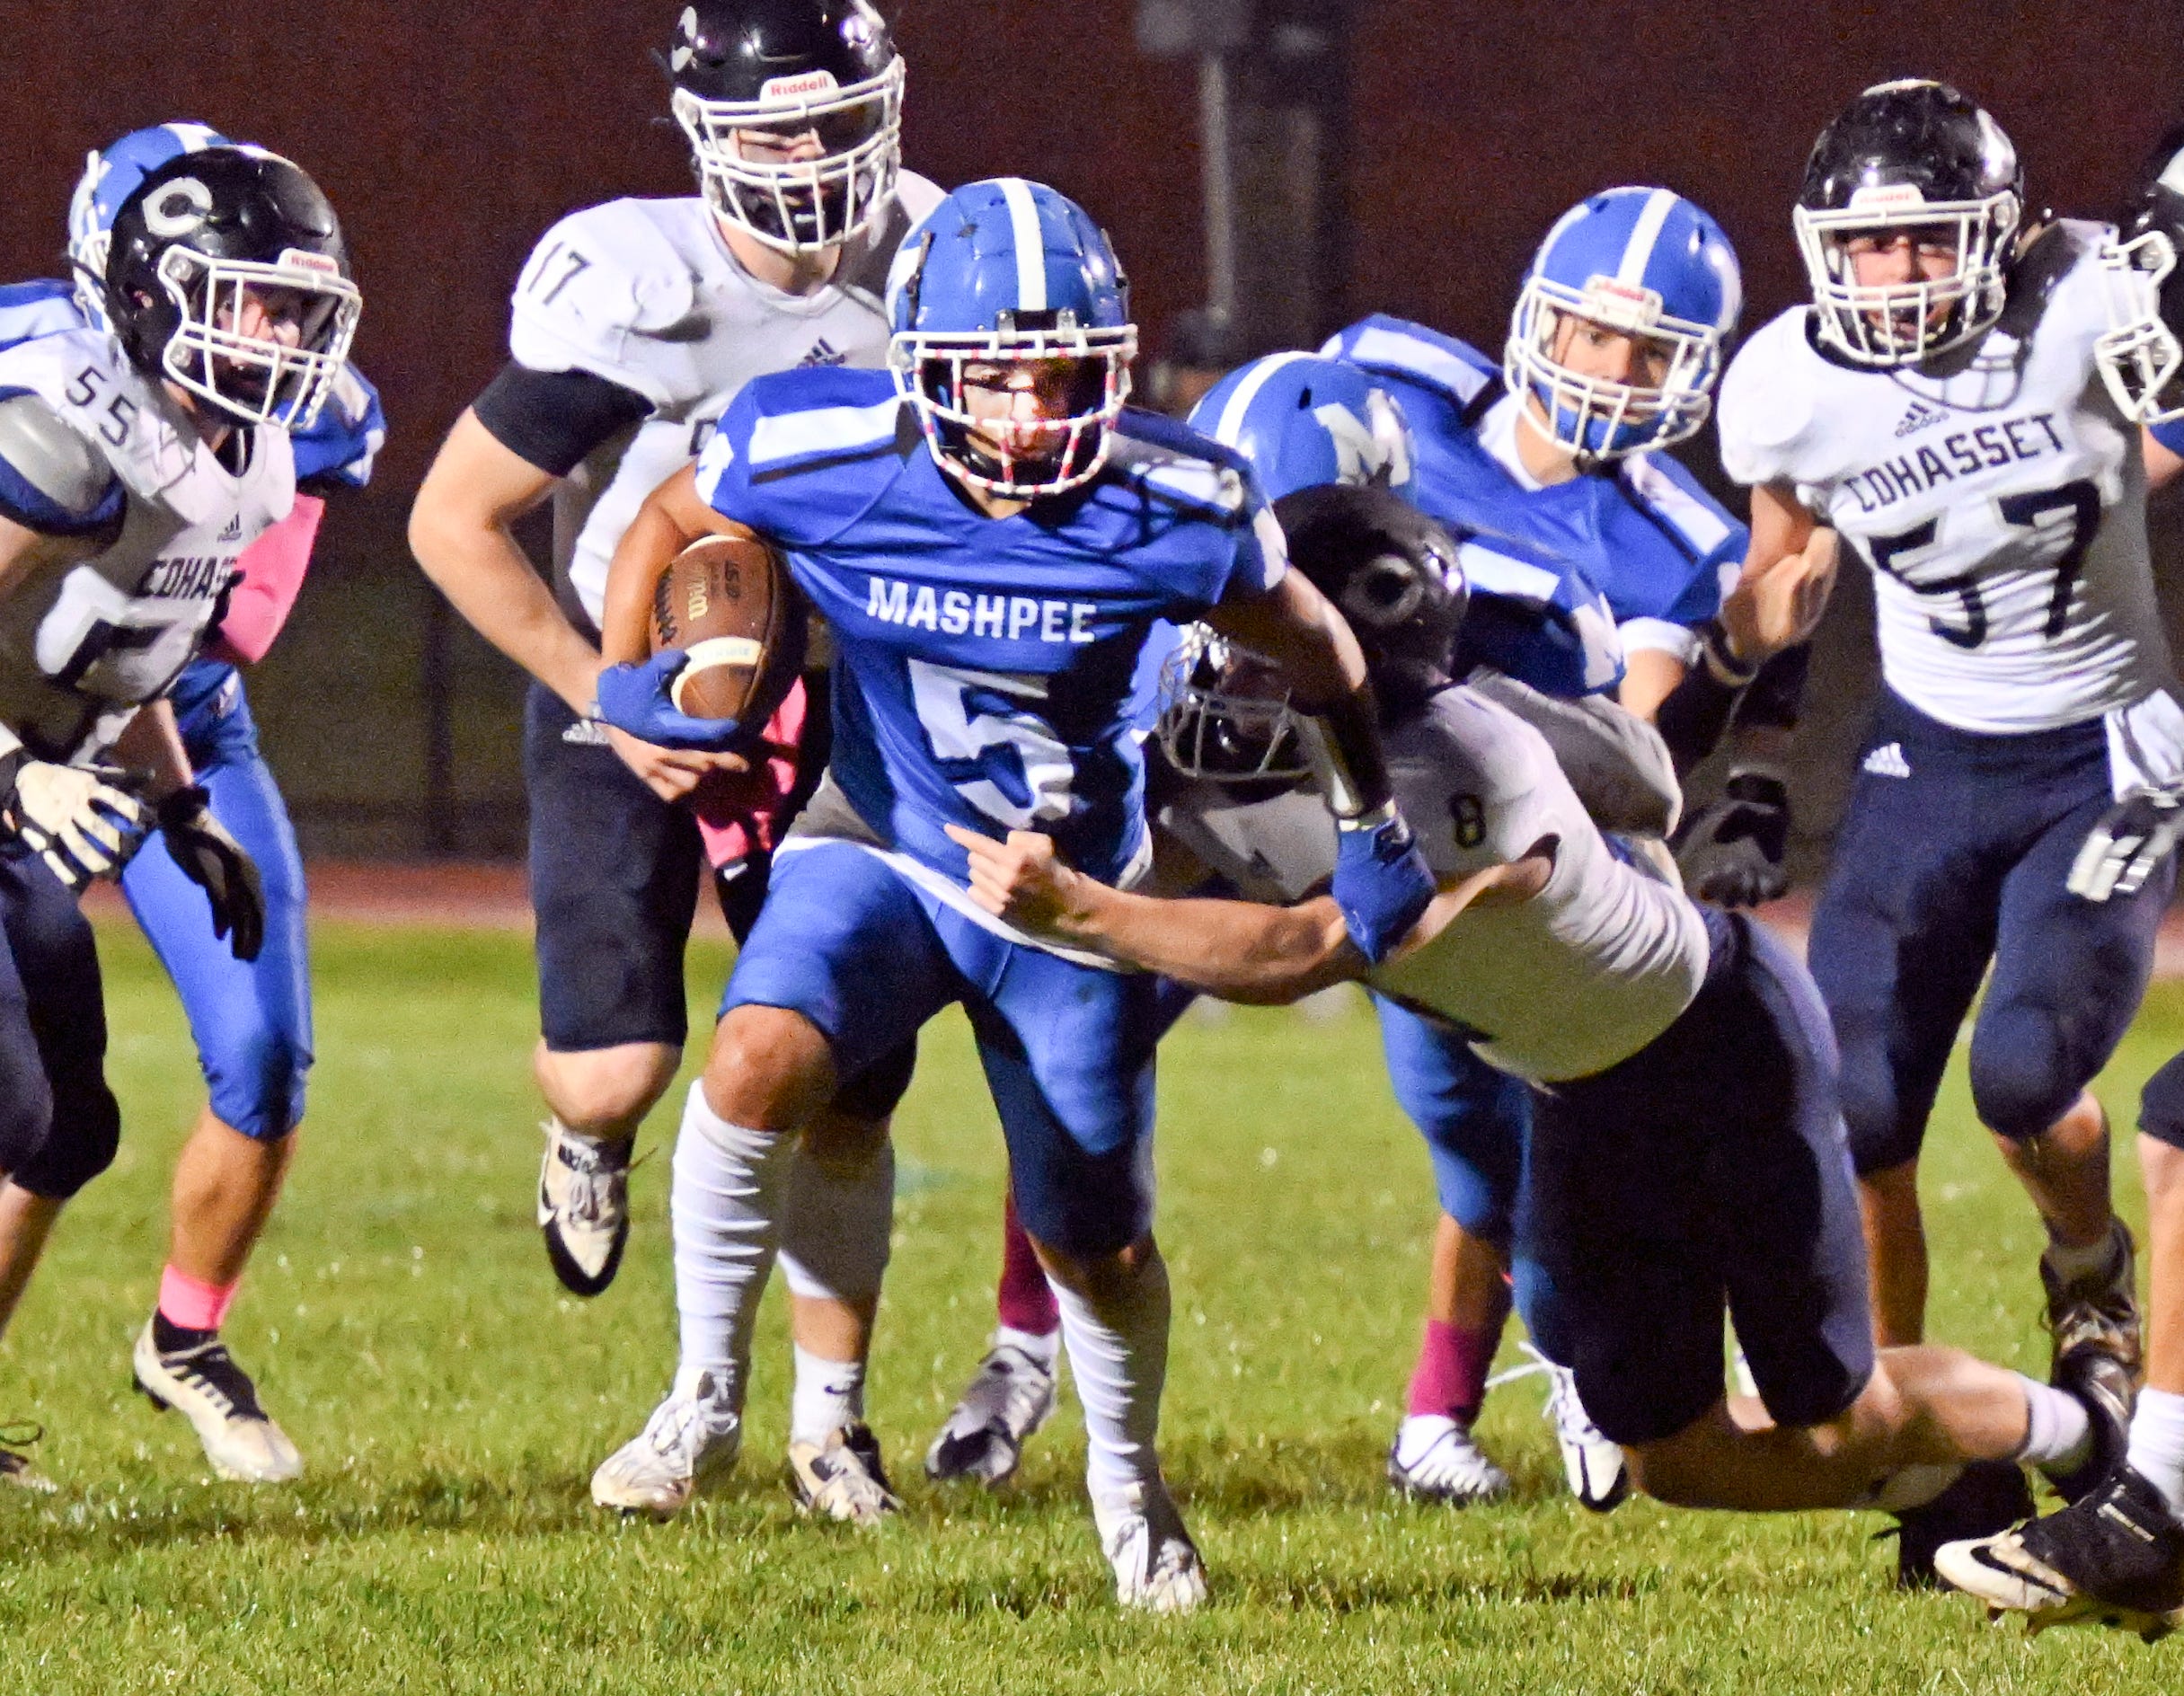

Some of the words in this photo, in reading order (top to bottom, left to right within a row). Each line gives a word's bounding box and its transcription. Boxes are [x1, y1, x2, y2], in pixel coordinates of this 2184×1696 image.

[770, 76, 828, 96] Riddell
[142, 176, 213, 238] C
[527, 241, 592, 306] 17
[65, 366, 137, 447] 55
[1844, 413, 2064, 512] COHASSET
[1867, 477, 2101, 649] 57
[866, 576, 1098, 644] MASHPEE
[907, 657, 1074, 830] 5
[1449, 793, 1487, 848] 8
